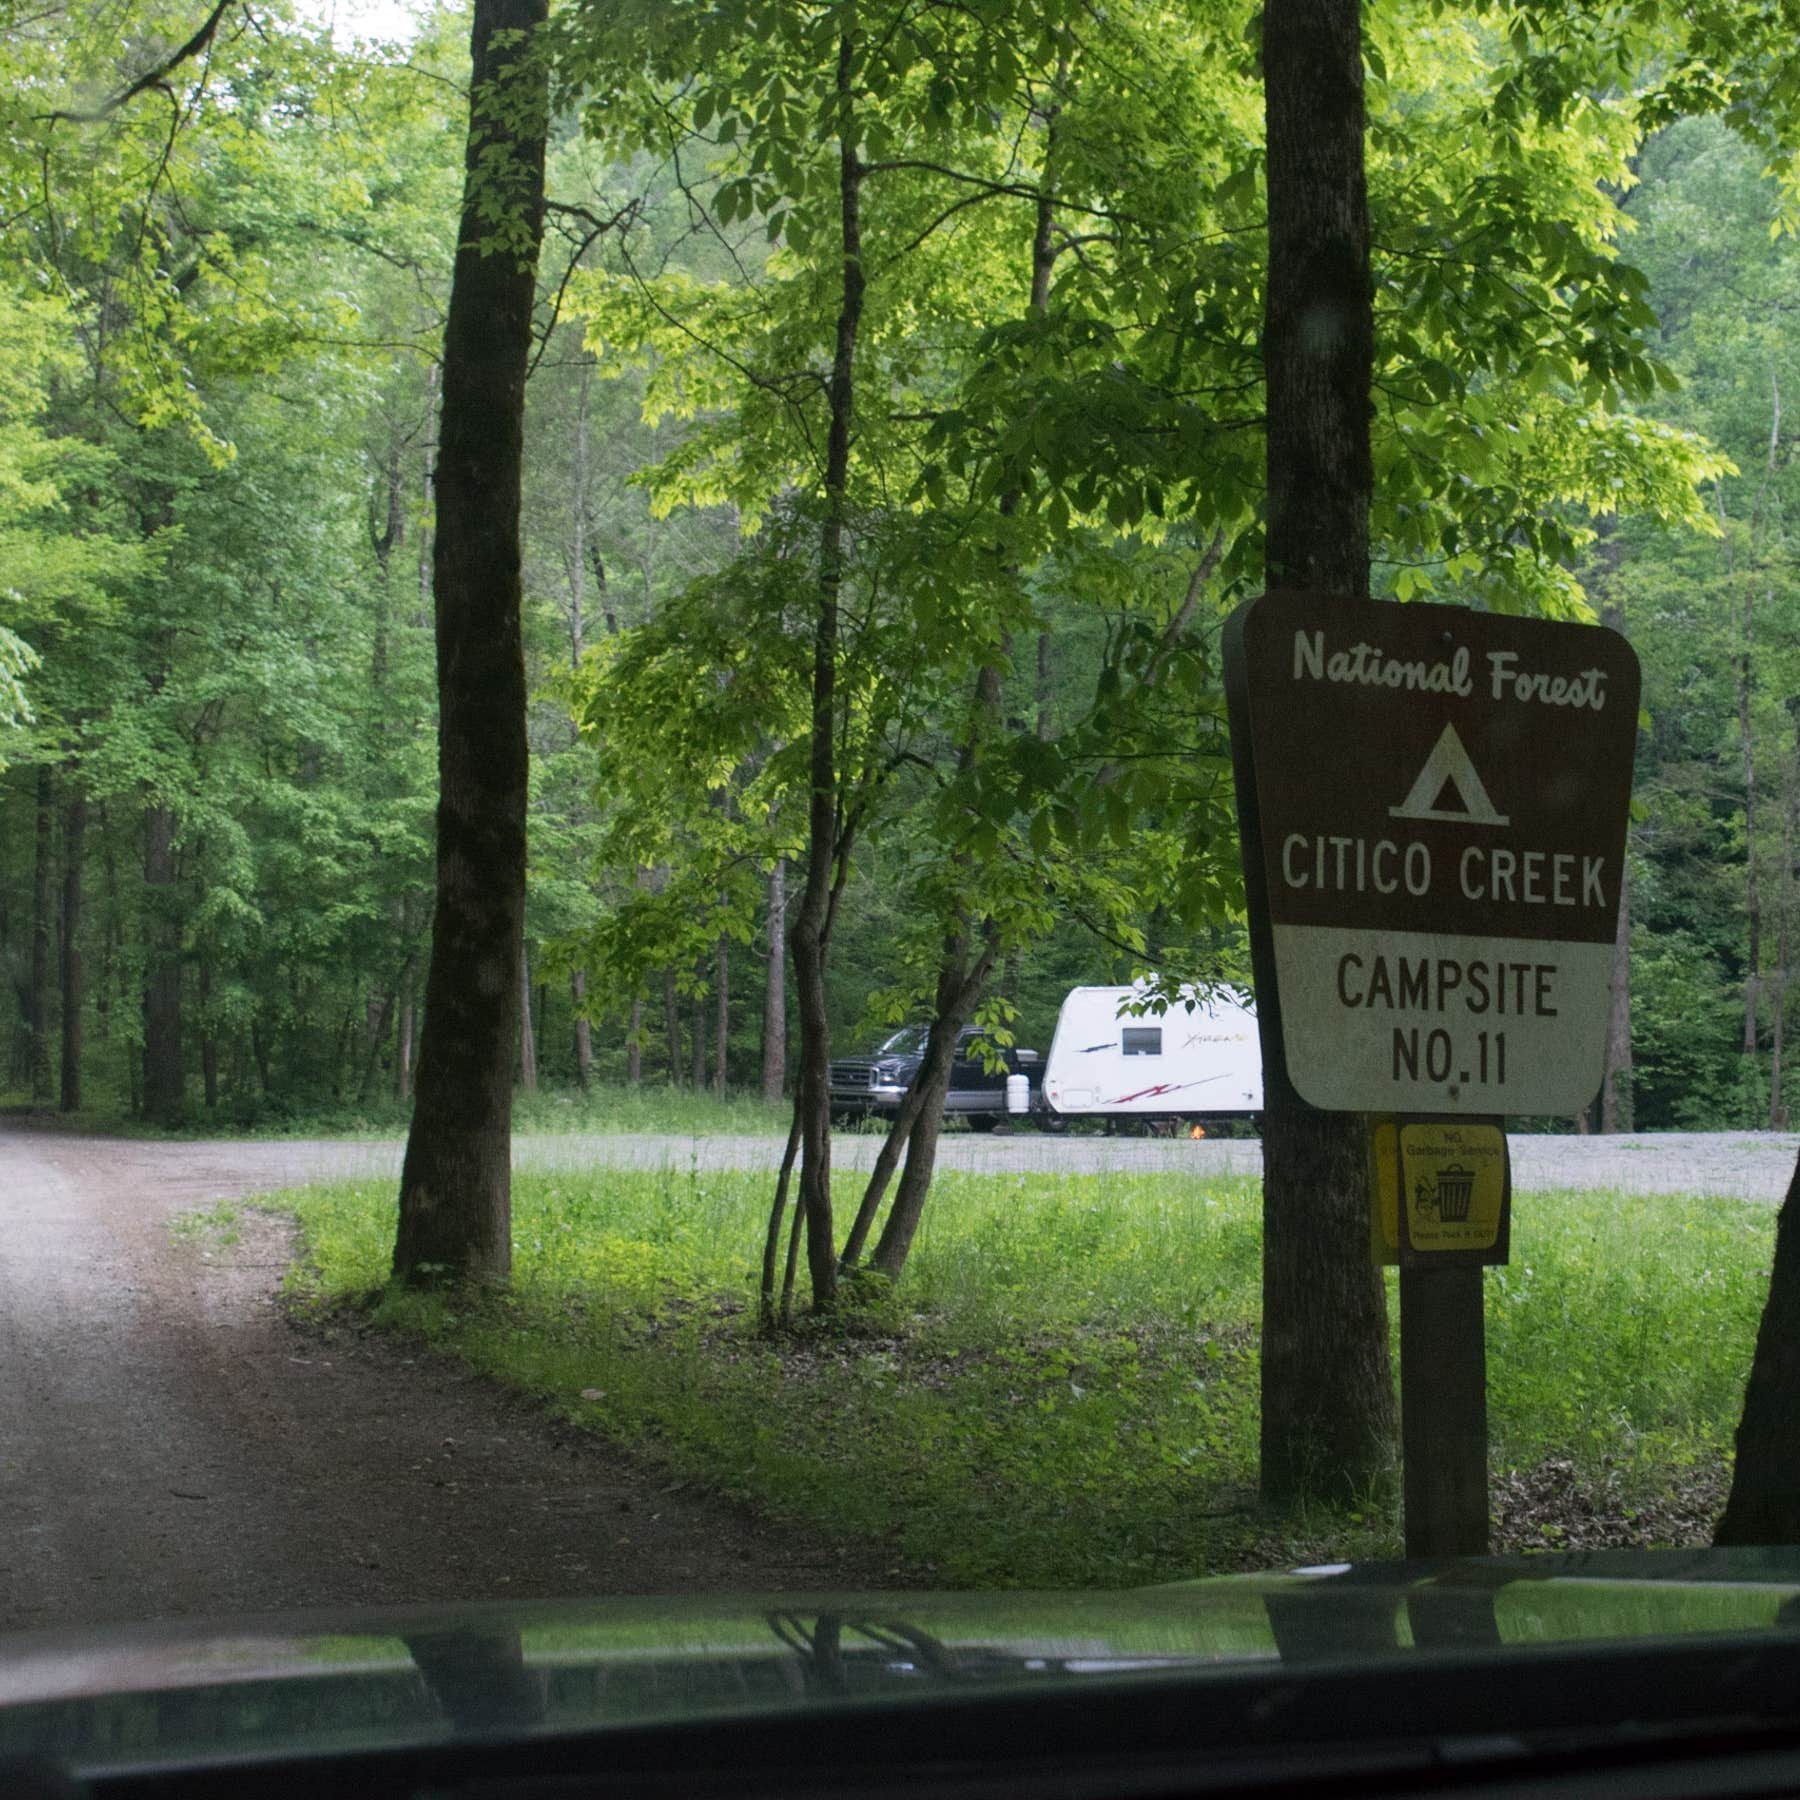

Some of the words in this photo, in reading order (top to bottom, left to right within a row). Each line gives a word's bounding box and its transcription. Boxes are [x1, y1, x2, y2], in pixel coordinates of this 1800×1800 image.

[1293, 630, 1473, 697] National
[1486, 651, 1608, 711] Forest
[1282, 833, 1432, 897] CITICO
[1460, 846, 1607, 907] CREEK
[1337, 953, 1558, 1017] CAMPSITE
[1392, 1028, 1505, 1085] NO.11
